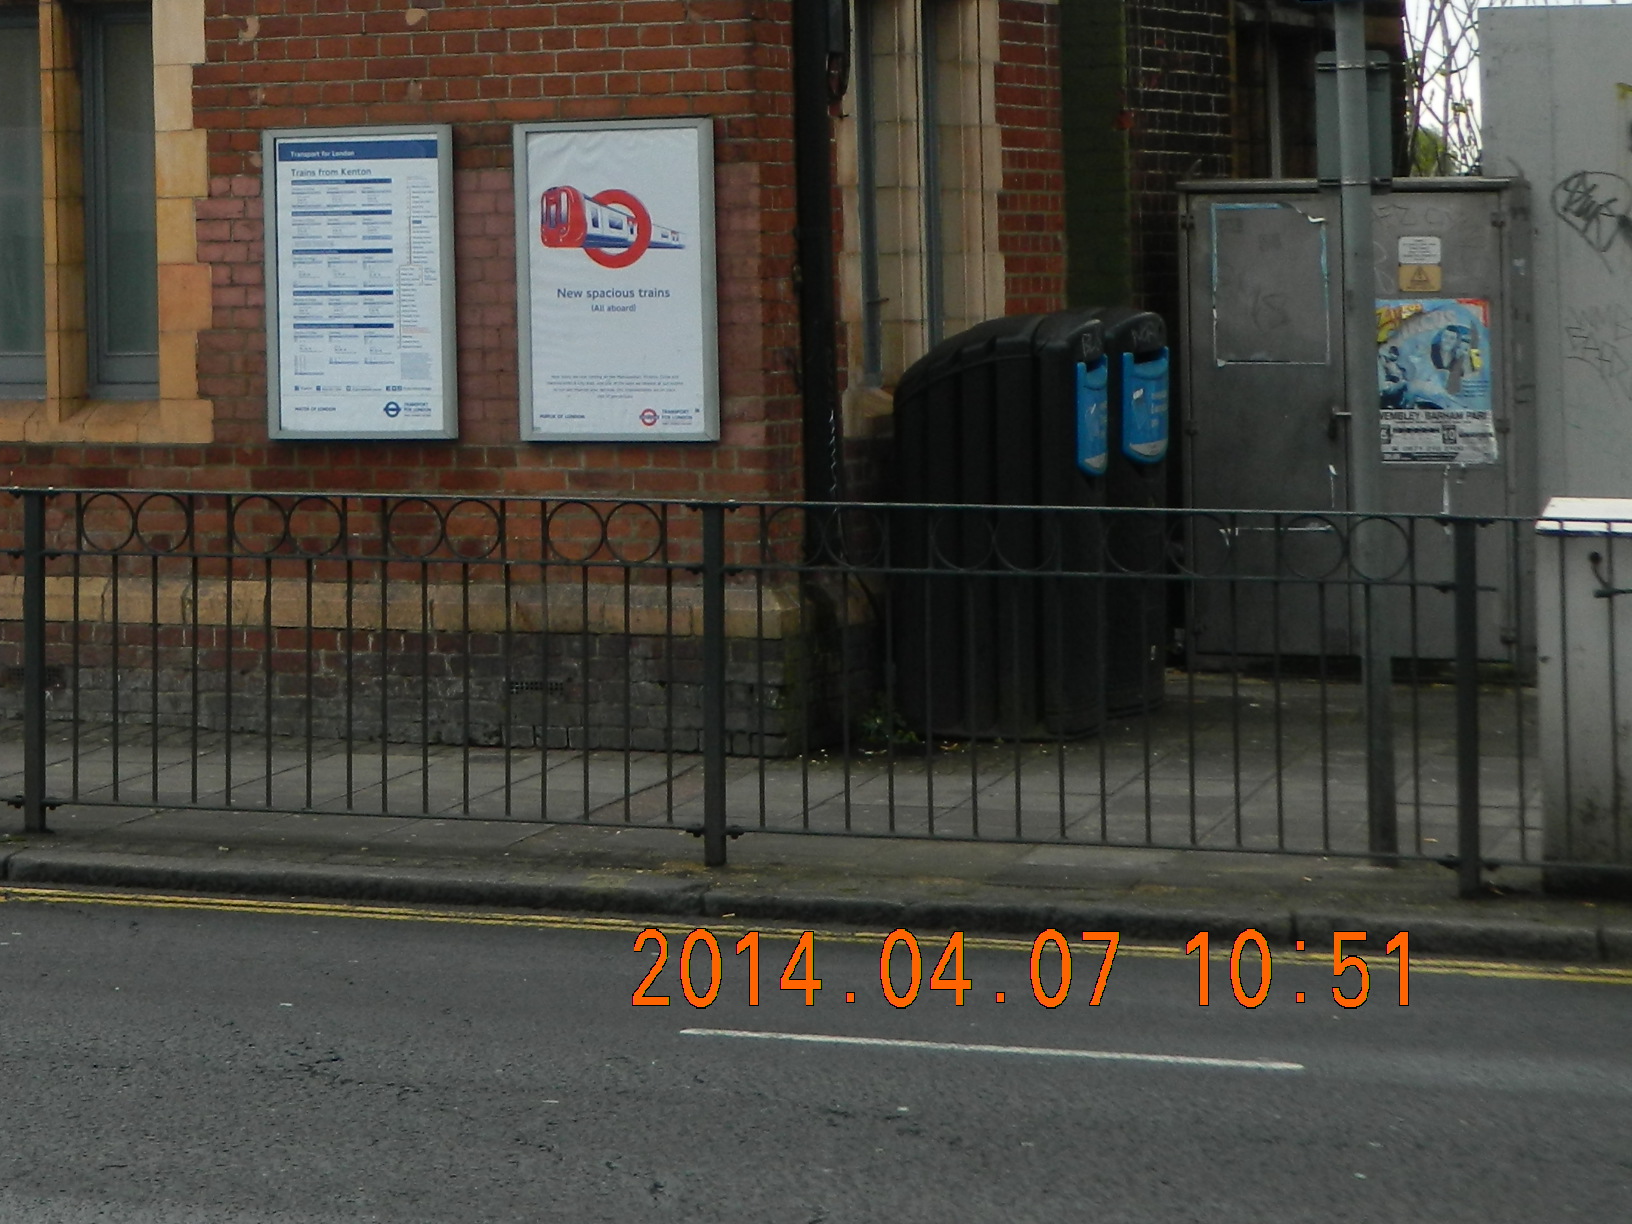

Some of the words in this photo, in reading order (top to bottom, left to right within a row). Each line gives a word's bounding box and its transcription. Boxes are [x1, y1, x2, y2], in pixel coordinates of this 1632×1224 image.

[290, 150, 320, 158] Transport
[291, 168, 315, 177] Trains
[318, 168, 338, 176] from
[341, 167, 371, 176] Kenton
[557, 288, 583, 298] New
[586, 287, 635, 300] spacious
[638, 287, 671, 298] trains
[591, 304, 605, 312] (All
[607, 303, 636, 312] aboard)
